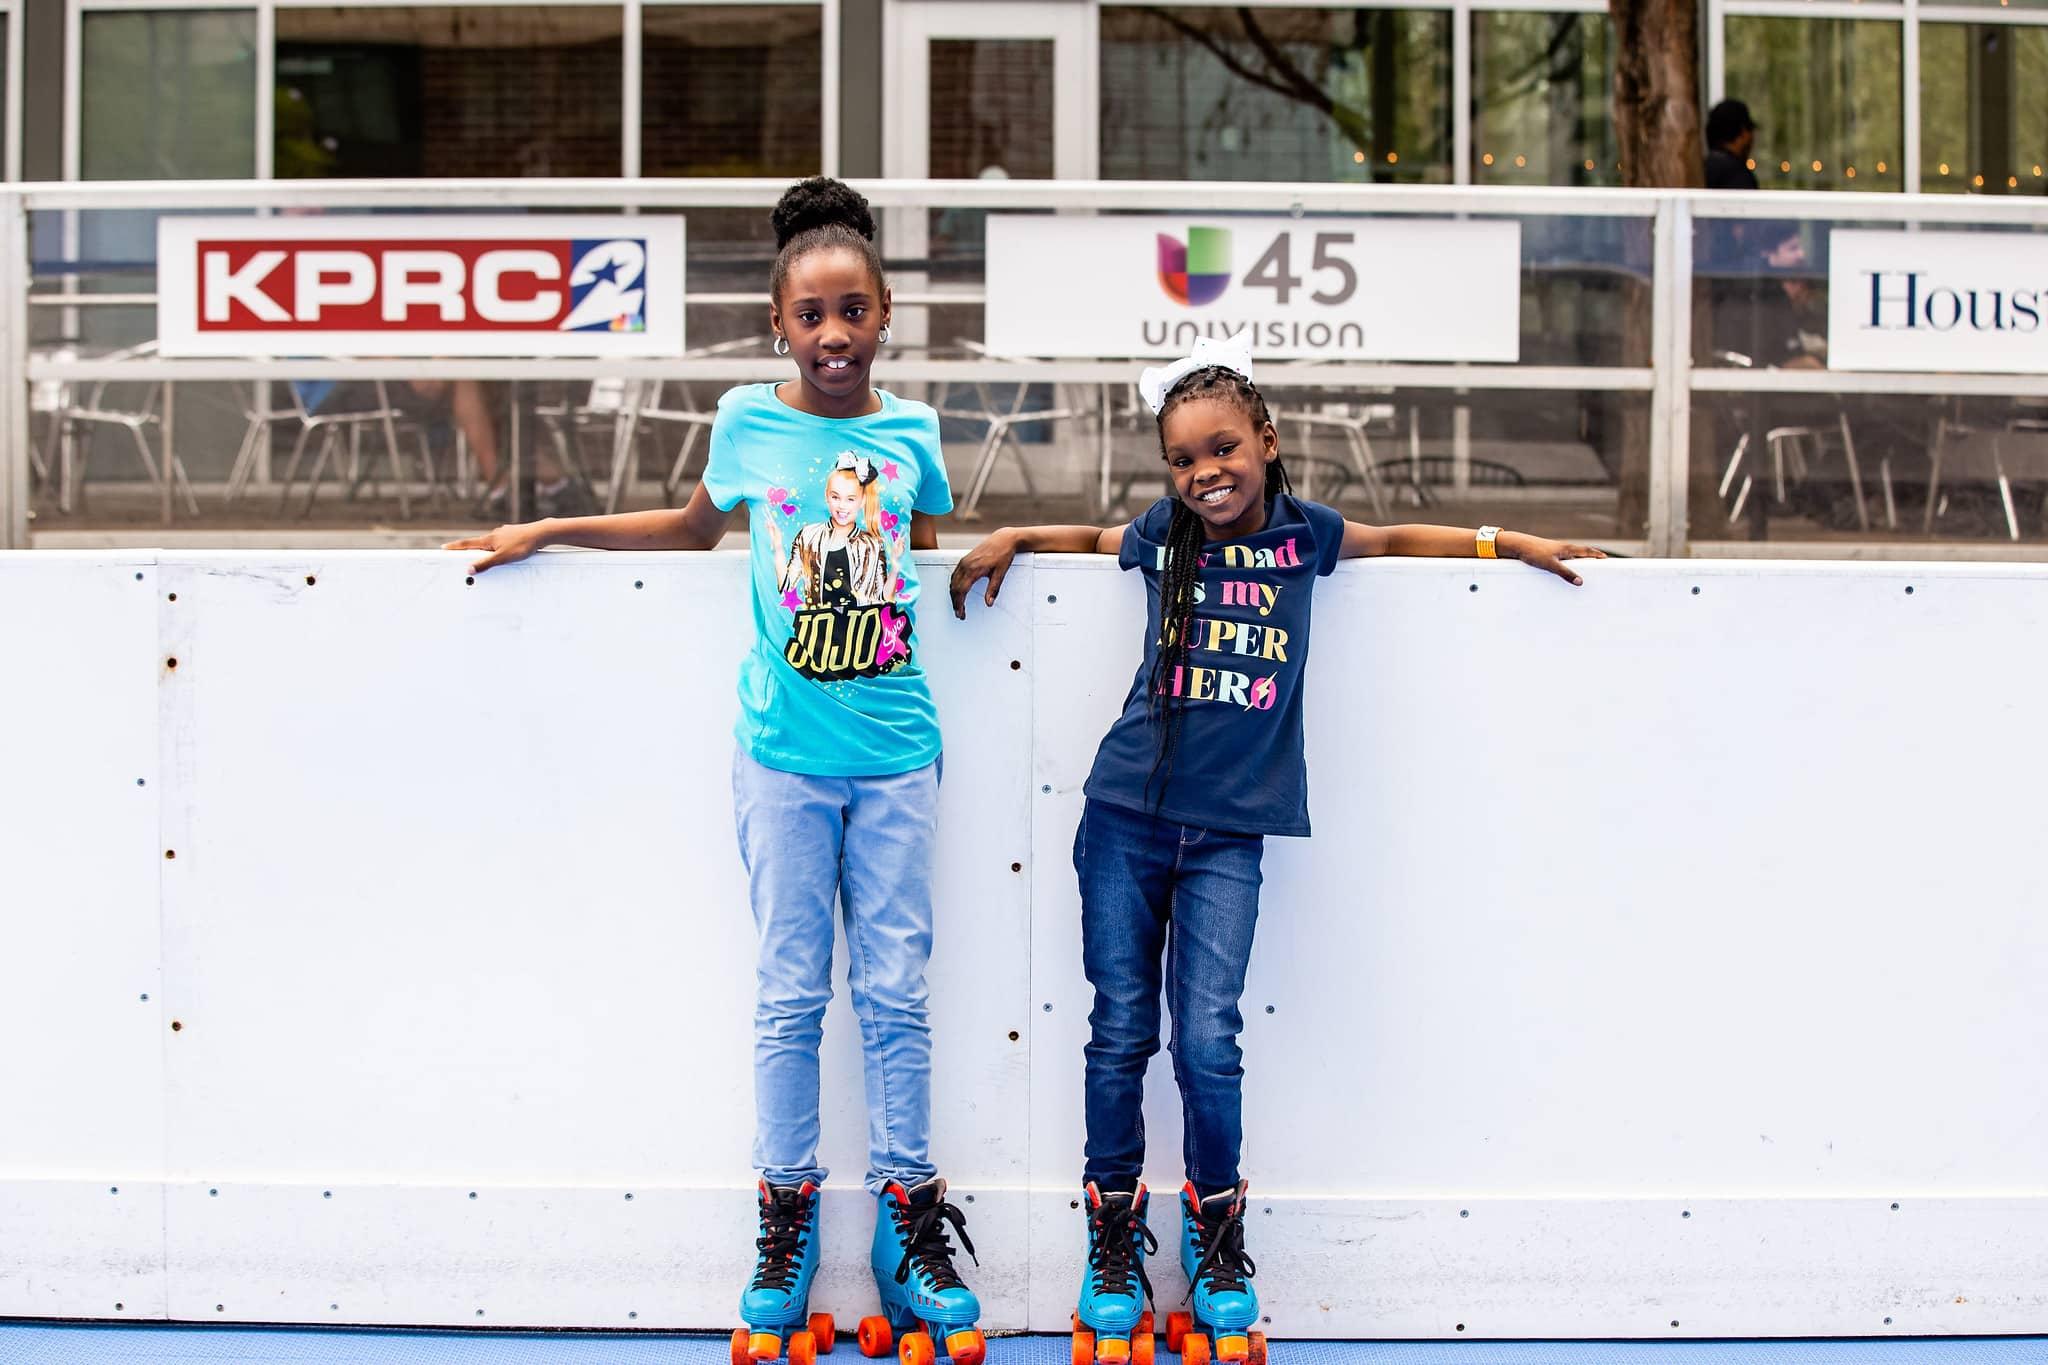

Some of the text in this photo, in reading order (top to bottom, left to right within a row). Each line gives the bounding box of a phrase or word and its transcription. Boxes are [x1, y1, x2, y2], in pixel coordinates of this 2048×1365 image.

[204, 240, 645, 330] KPRC 2
[1242, 231, 1358, 306] 45
[1859, 269, 2048, 332] Hous
[1222, 538, 1303, 569] Dad
[1220, 581, 1282, 617] my
[786, 607, 881, 673] JOJO
